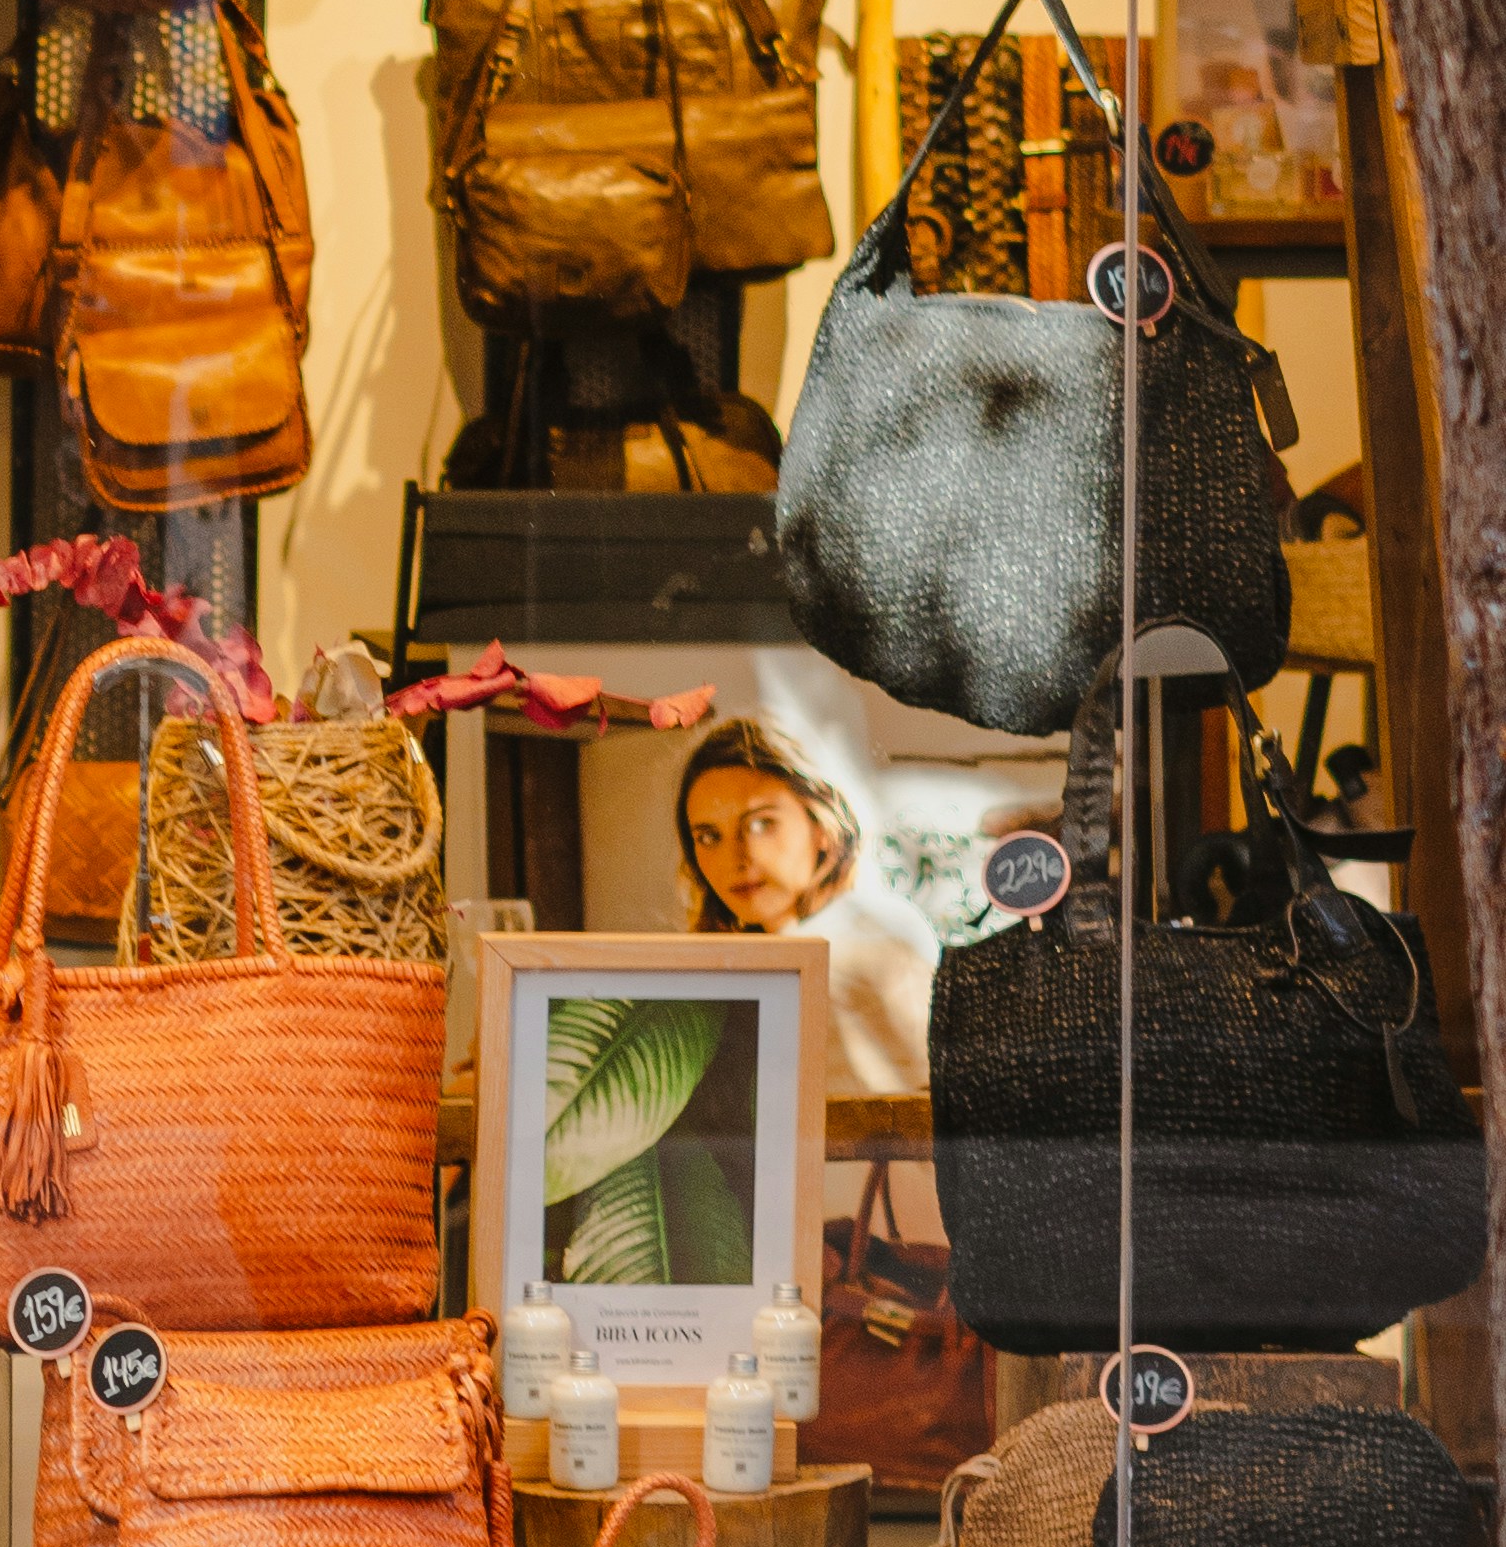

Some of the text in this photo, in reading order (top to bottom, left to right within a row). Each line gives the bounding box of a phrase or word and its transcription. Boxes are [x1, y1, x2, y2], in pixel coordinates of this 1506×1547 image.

[22, 1285, 85, 1343] 159€
[596, 1326, 703, 1343] BIBA ICONS
[102, 1348, 159, 1399] 145€
